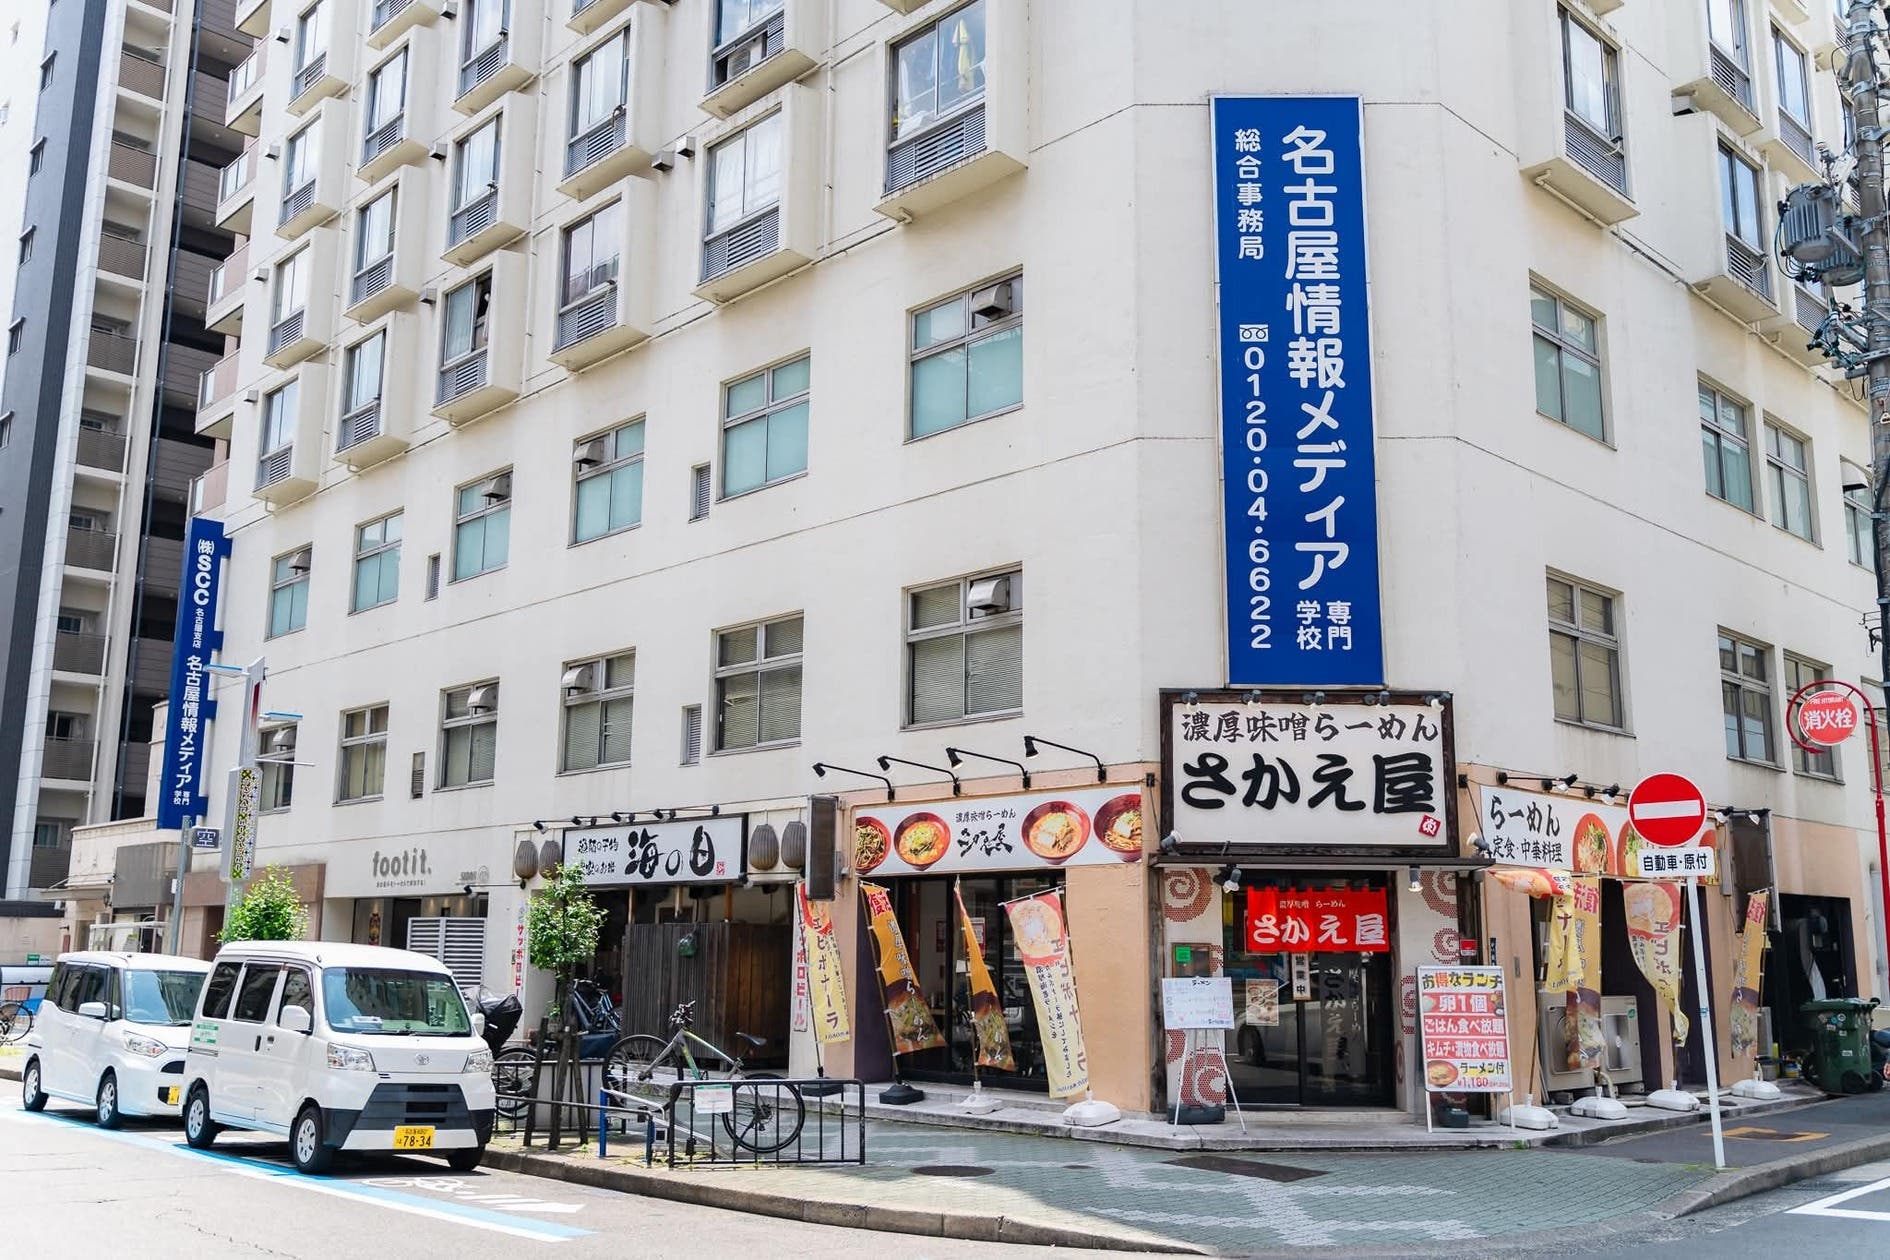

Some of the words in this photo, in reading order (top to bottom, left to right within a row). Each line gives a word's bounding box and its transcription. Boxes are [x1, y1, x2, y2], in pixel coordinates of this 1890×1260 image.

[1234, 128, 1264, 260] 総合事務局
[1281, 125, 1349, 590] 名古屋情報メディア
[176, 655, 203, 789] 名古屋情報メディア
[1181, 710, 1439, 743] 濃厚味噌らーめん
[1803, 708, 1853, 730] 消火栓
[1181, 752, 1436, 814] さかえ屋
[1490, 795, 1560, 837] らーめん
[196, 829, 216, 848] 空
[625, 825, 715, 879] 海の日
[1492, 835, 1563, 863] 定食・中華料理
[372, 848, 432, 877] footit.
[1643, 853, 1708, 871] 自動車・原付
[1253, 913, 1386, 945] さかえ屋
[1422, 971, 1503, 990] お得なランチ
[1439, 994, 1488, 1013] 卵1個
[1424, 1018, 1505, 1034] ごはん食べ放題
[1460, 1062, 1505, 1075] ラーメン付
